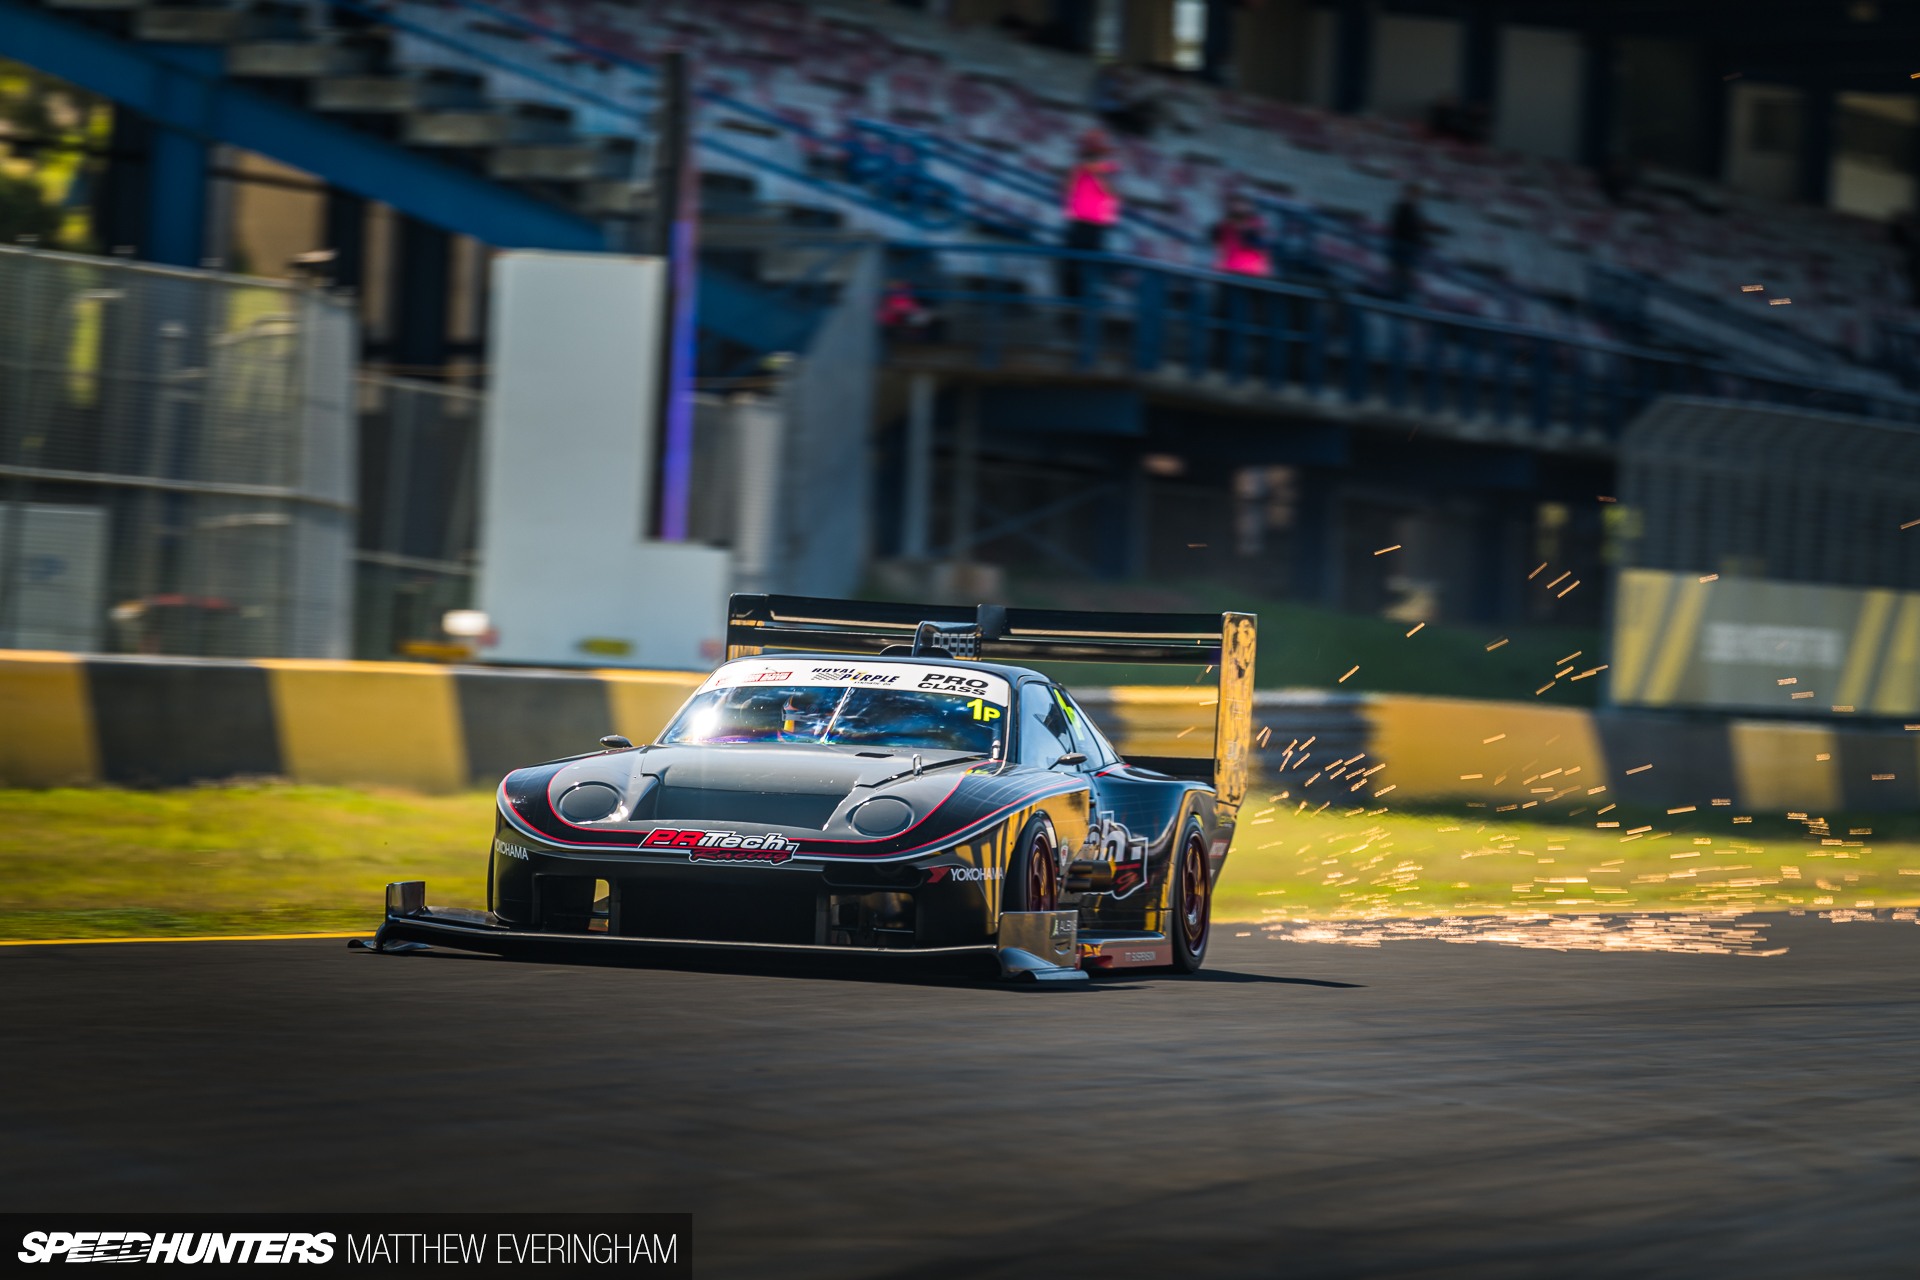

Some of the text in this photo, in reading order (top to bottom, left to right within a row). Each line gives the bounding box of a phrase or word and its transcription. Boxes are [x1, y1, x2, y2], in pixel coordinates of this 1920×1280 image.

[839, 671, 900, 683] PURPLE
[920, 673, 989, 689] PRO
[917, 682, 987, 696] CLASS
[966, 698, 1001, 722] 1P
[691, 849, 790, 863] Racing
[950, 867, 1004, 882] YOKOHAMA
